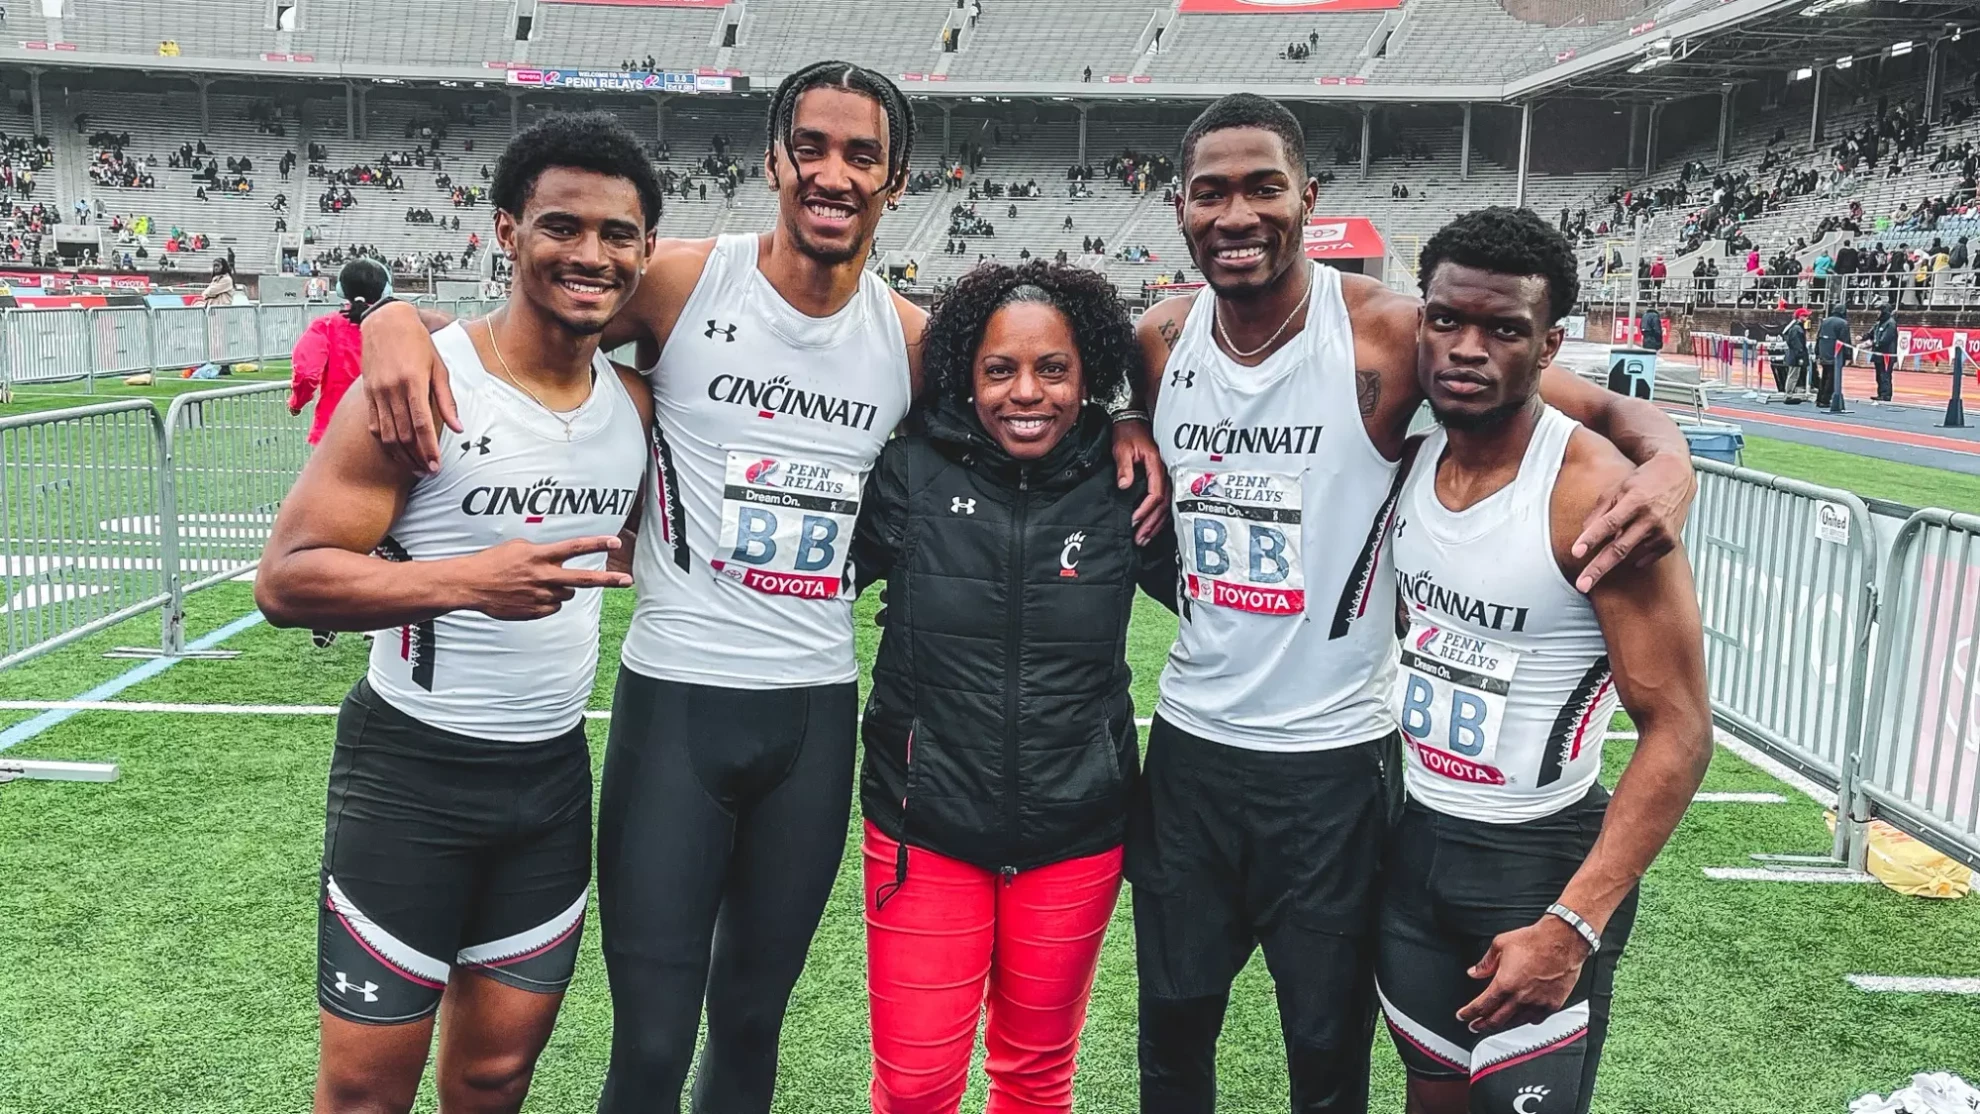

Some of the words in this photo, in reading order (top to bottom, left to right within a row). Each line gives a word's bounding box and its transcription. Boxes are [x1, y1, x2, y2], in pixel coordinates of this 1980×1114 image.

[565, 77, 597, 88] PENN
[600, 78, 643, 90] RELAYS
[1304, 242, 1354, 252] YOTA
[1911, 338, 1943, 351] TOYOTA
[707, 374, 878, 431] CINCINNATI
[1174, 417, 1324, 454] CINCINNATI
[788, 463, 831, 479] PENN
[782, 475, 844, 494] RELAYS
[1225, 474, 1271, 488] PENN
[746, 490, 781, 504] Dream
[782, 495, 800, 507] On.
[1225, 488, 1283, 503] RELAYS
[1198, 502, 1227, 514] Dream
[1822, 511, 1846, 529] United
[751, 573, 825, 596] TOYOTA
[1217, 585, 1290, 610] TOYOTA
[1395, 567, 1529, 632] INCINNATI
[1443, 632, 1486, 654] PENN
[1414, 657, 1437, 673] Dream
[1439, 645, 1499, 671] RELAYS
[1420, 748, 1491, 781] TOYOTA
